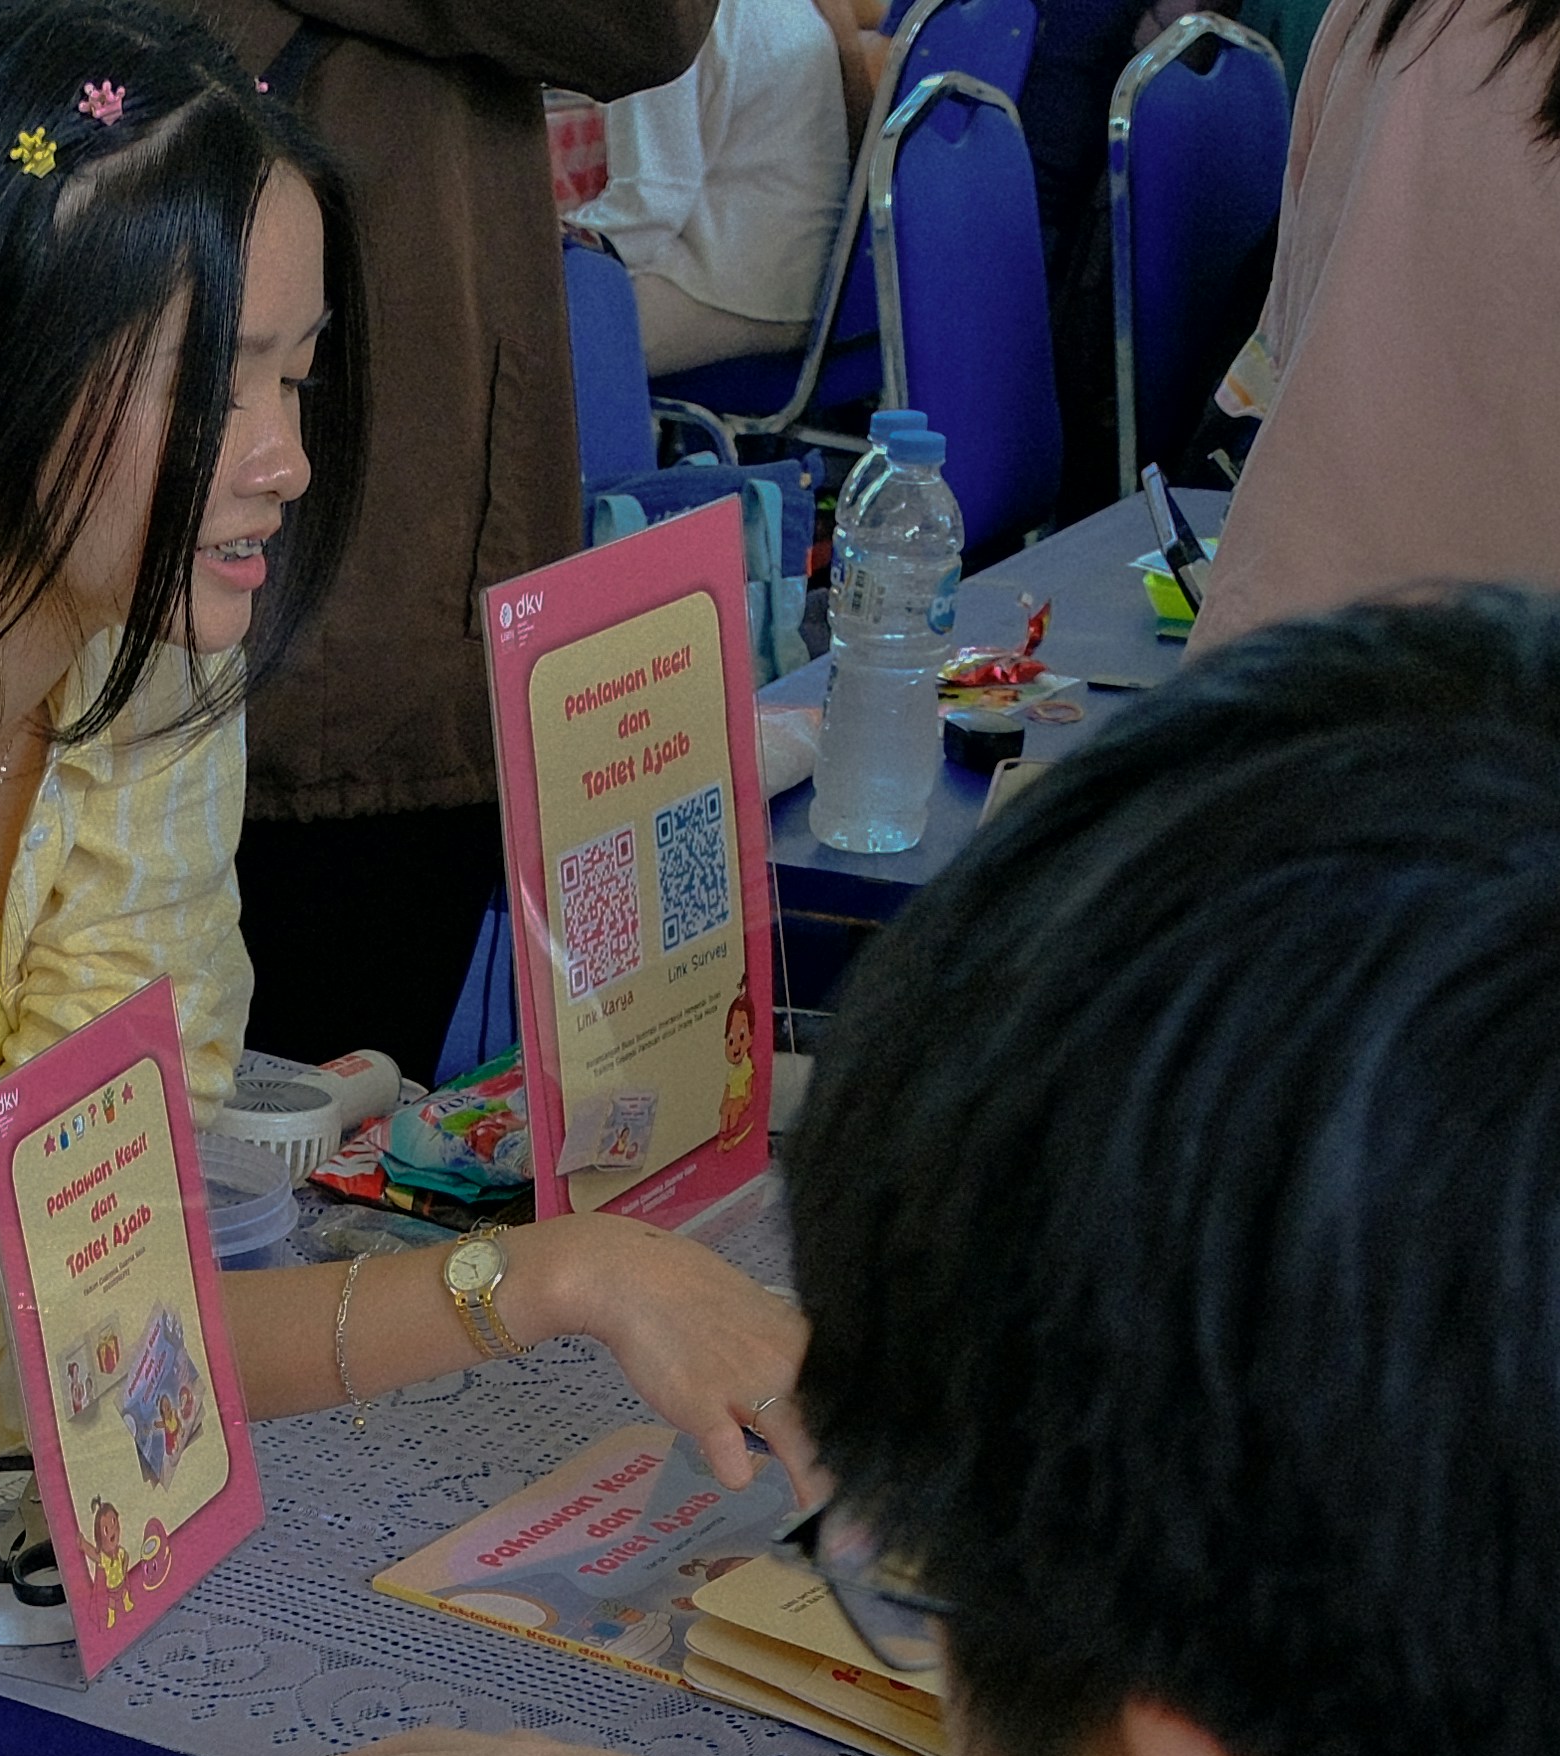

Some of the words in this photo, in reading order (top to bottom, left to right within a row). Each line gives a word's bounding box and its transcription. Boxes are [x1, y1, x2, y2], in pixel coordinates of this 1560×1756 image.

[563, 667, 648, 722] Pahlawan
[651, 644, 692, 684] Kecil
[617, 707, 651, 740] dan
[581, 755, 636, 801] Toilet
[643, 730, 691, 775] Ajaib
[667, 961, 688, 984] Link
[691, 941, 728, 972] Survey
[576, 1008, 599, 1033] Link
[600, 989, 635, 1018] Karya
[46, 1159, 113, 1219] Pahlawan
[114, 1131, 148, 1171] Kecil
[90, 1191, 119, 1223] dan
[65, 1233, 110, 1279] Toilet
[112, 1203, 152, 1248] Ajaib
[476, 1494, 604, 1568] Pahlawan
[592, 1453, 665, 1494] Kecil
[577, 1534, 661, 1576] Toilet
[649, 1490, 722, 1535] Ajaib
[586, 1506, 643, 1539] dan
